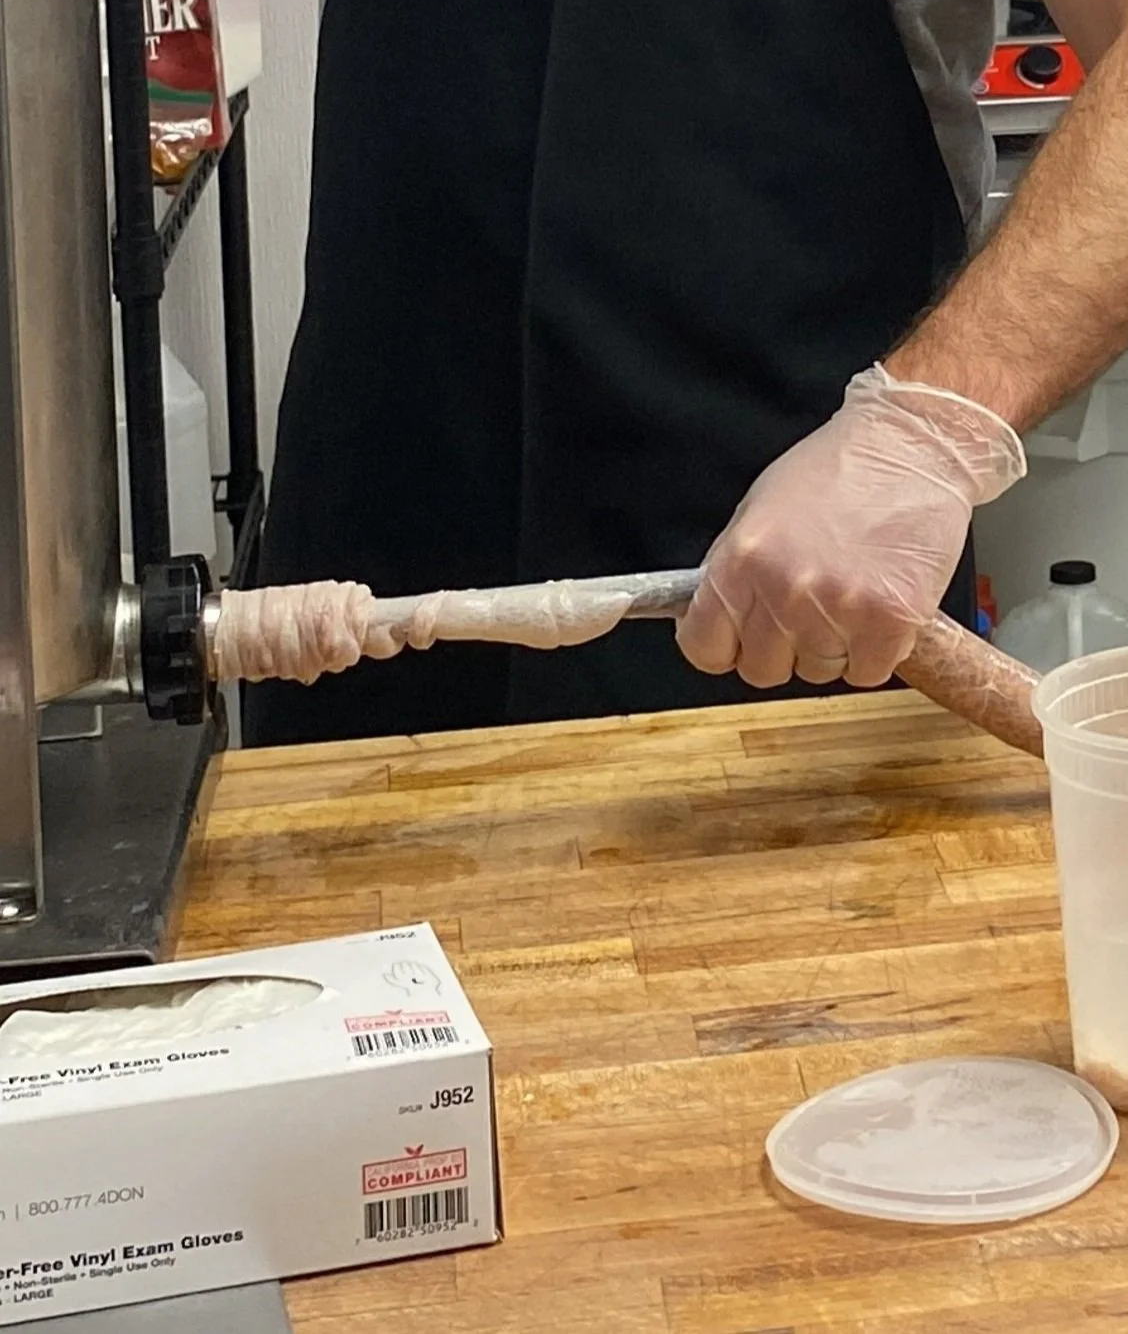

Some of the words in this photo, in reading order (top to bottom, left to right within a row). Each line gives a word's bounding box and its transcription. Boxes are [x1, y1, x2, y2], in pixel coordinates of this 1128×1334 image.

[57, 1063, 102, 1078] Vinyl
[109, 1056, 161, 1071] Exam
[166, 1047, 230, 1063] Gloves
[430, 1085, 475, 1110] J952
[367, 1164, 463, 1190] COMPLIANT
[28, 1186, 145, 1217] 800.777.4DON
[376, 1229, 415, 1244] 60282
[420, 1220, 458, 1236] 50952
[69, 1248, 116, 1267] Vinyl
[122, 1239, 175, 1260] Exam
[180, 1229, 244, 1250] Gloves
[13, 1271, 78, 1292] Non-Sterile
[89, 1265, 124, 1280] Single
[126, 1260, 149, 1273] Use
[150, 1256, 176, 1269] Only
[13, 1288, 54, 1304] LARGE
